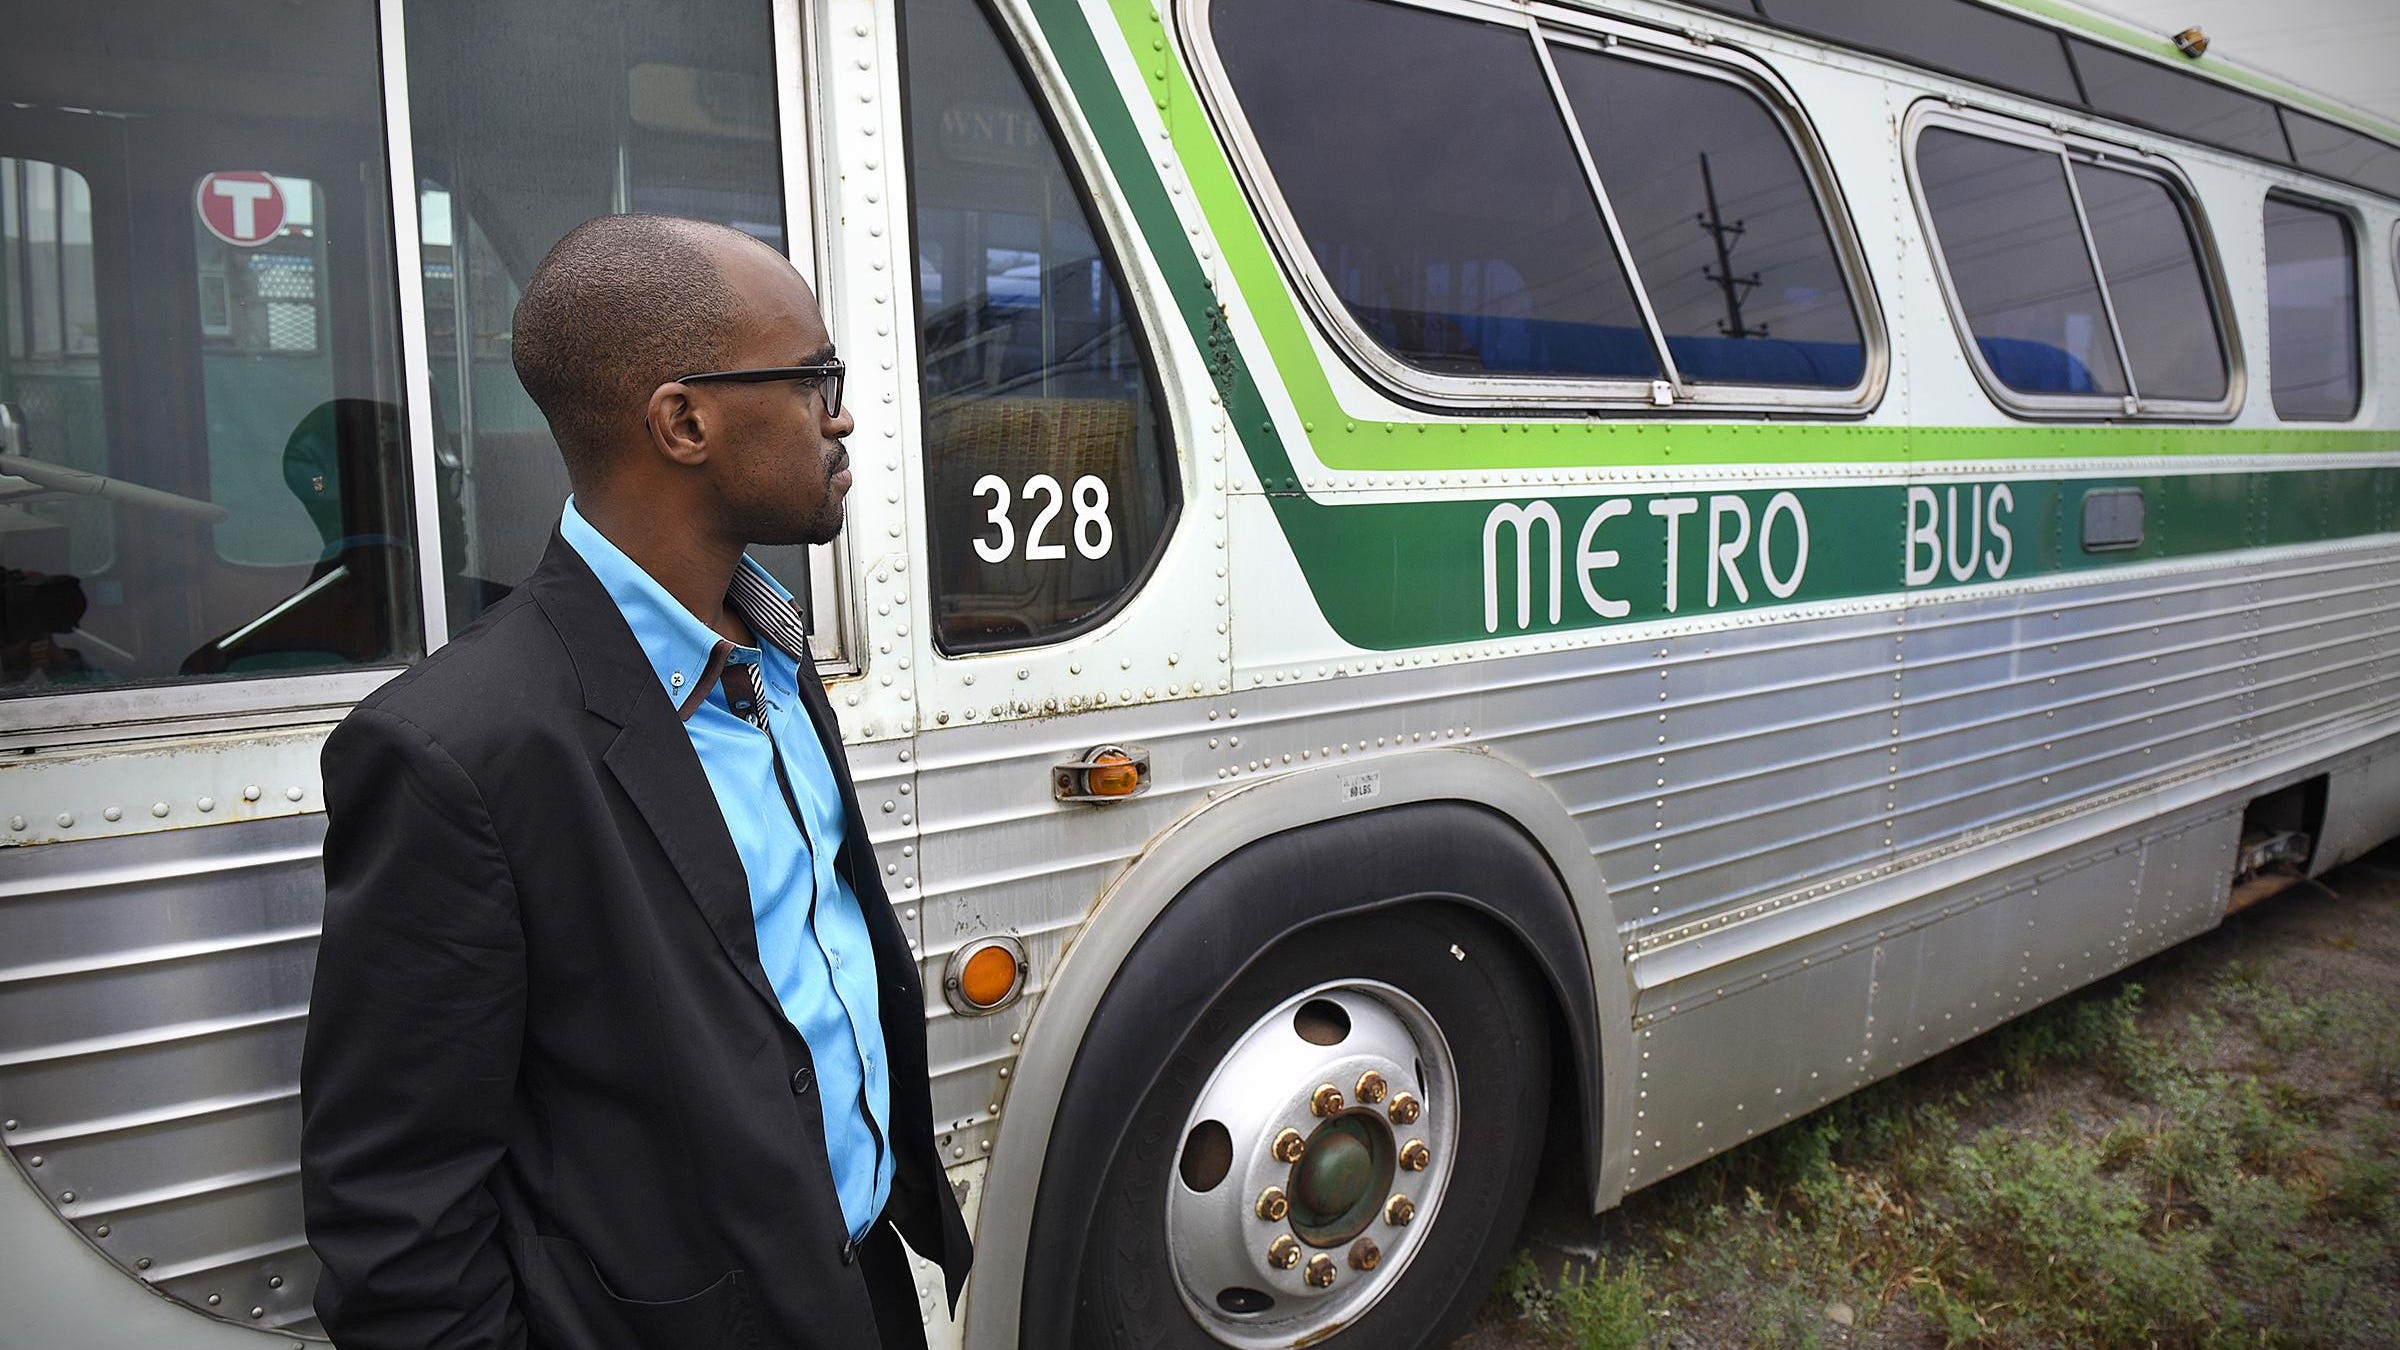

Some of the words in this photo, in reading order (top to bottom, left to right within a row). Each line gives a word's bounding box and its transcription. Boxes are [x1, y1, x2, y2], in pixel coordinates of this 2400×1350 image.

[214, 180, 272, 238] T
[972, 474, 1113, 563] 328
[1483, 491, 1809, 633] METRO
[1905, 483, 2015, 587] BUS
